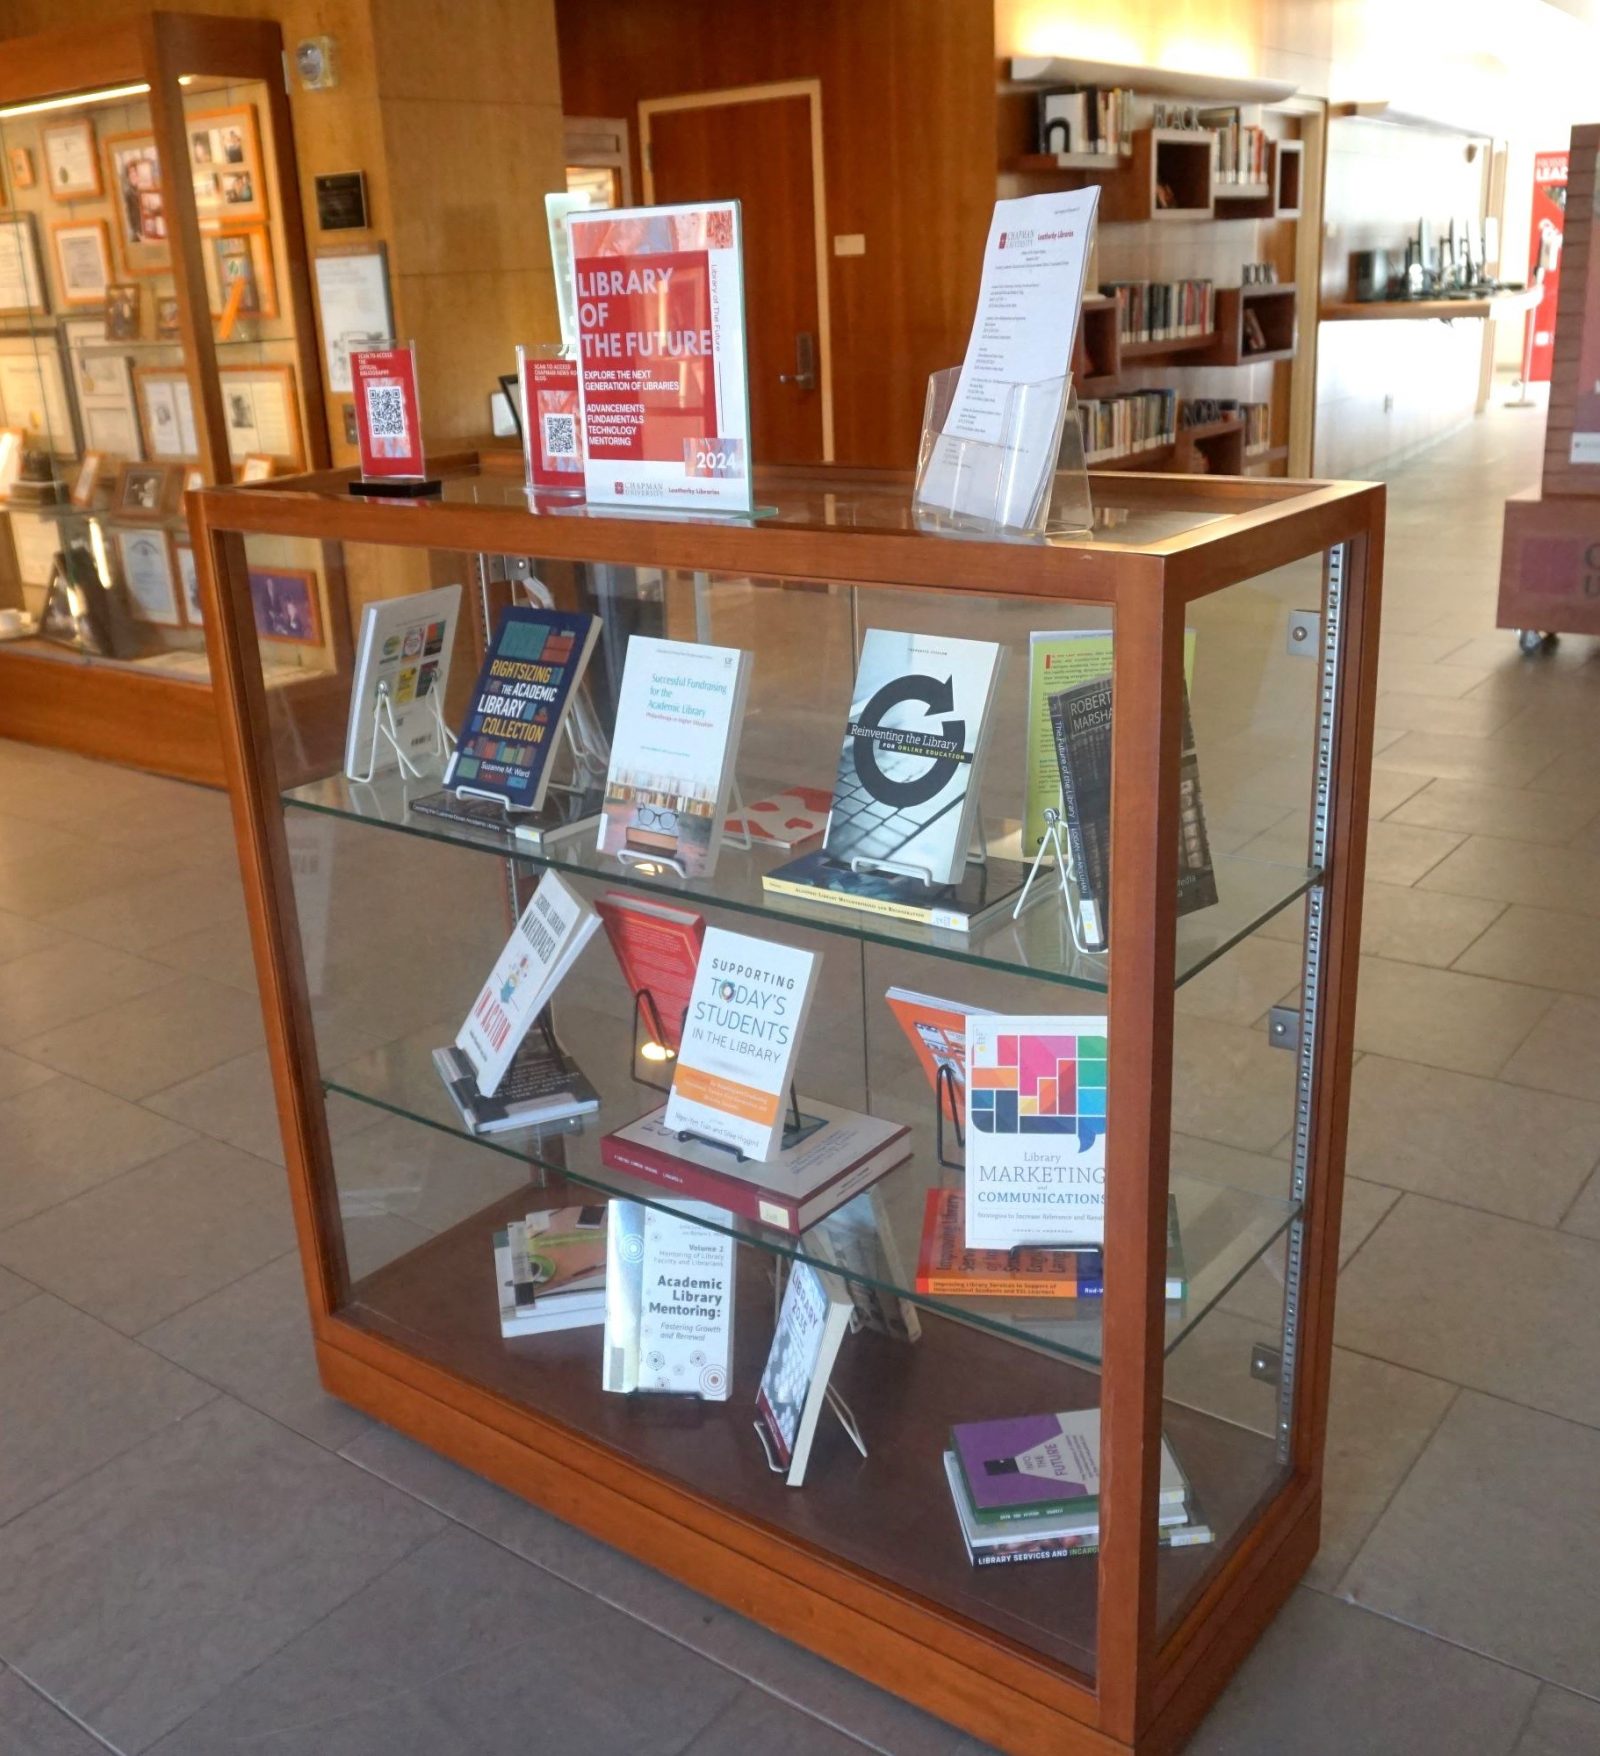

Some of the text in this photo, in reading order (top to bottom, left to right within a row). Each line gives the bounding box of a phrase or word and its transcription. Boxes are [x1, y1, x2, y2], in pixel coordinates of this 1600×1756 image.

[577, 267, 673, 297] LIBRARY
[711, 264, 719, 294] Library
[580, 302, 609, 328] OF
[581, 329, 713, 358] THE FUTURE
[584, 369, 652, 379] EXPLORE THE NEXT
[585, 381, 680, 391] GENERATION OF LIBRARIES
[586, 404, 645, 413] ADVANCEMENTS
[587, 415, 644, 424] FUNDAMENTALS
[588, 425, 637, 435] TECHNOLOGY
[589, 436, 632, 446] MENTORING
[696, 451, 737, 469] 2024
[490, 660, 552, 684] RIGHTSIZING
[501, 683, 557, 702] THE ACADEMIC
[650, 686, 672, 698] for the
[652, 673, 728, 695] Successful Fundraising
[477, 694, 526, 718] LIBRARY
[647, 699, 706, 718] Academic Library
[1070, 690, 1112, 716] ROBERT
[481, 717, 545, 743] COLLECTION
[851, 725, 957, 751] Reinventing the Library
[897, 745, 923, 754] ONLINE
[925, 749, 965, 760] EDUCATION
[1057, 738, 1067, 764] Future
[481, 761, 505, 773] Suzanne
[514, 768, 530, 778] Ward
[1063, 777, 1071, 788] the
[1065, 789, 1076, 818] Library
[712, 958, 795, 990] SUPPORTING
[711, 977, 787, 1015] TODAY'S
[480, 1000, 511, 1053] ACTION
[694, 1001, 790, 1045] STUDENTS
[692, 1028, 781, 1063] IN THE LIBRARY
[1024, 1152, 1061, 1163] Library
[979, 1165, 1105, 1184] MARKETING
[689, 1243, 717, 1253] Volume
[657, 1275, 722, 1290] Academic
[672, 1289, 722, 1306] Library
[792, 1272, 818, 1329] LIBRARY
[649, 1302, 721, 1320] Mentoring:
[660, 1332, 674, 1340] and
[661, 1321, 721, 1334] Fostering Growth
[1044, 1443, 1068, 1476] FUTURE
[978, 1555, 1011, 1565] LIBRARY
[1013, 1551, 1050, 1561] SERVICES
[1052, 1549, 1068, 1558] AND
